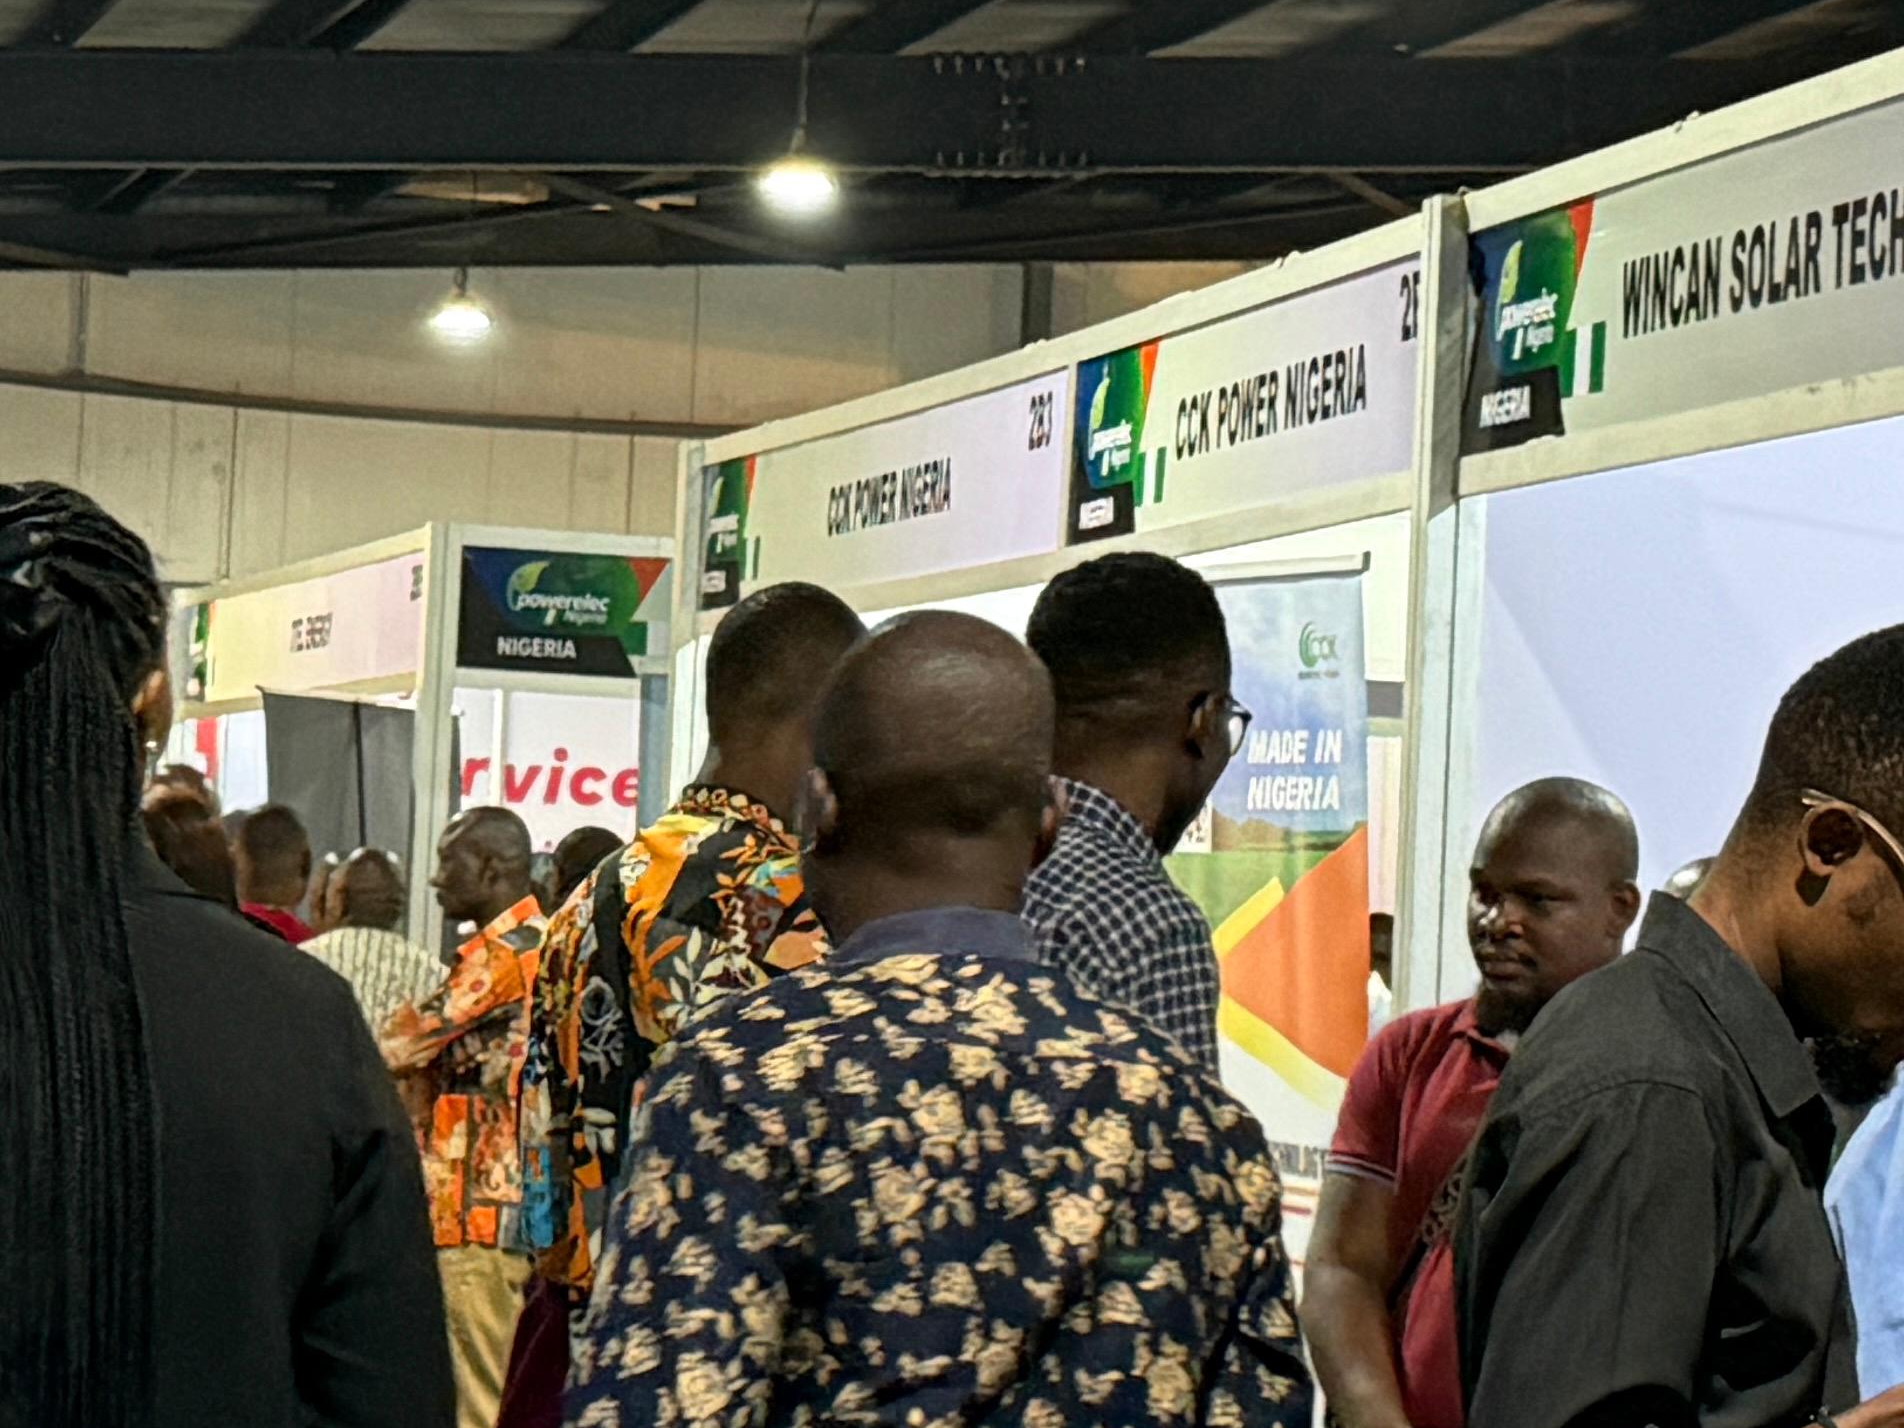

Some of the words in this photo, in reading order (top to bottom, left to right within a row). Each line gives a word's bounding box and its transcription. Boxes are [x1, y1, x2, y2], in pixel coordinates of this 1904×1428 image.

[1623, 236, 1722, 338] WINCAN
[1730, 210, 1822, 313] SOLAR
[1175, 390, 1213, 461] CCK
[1216, 370, 1279, 450] POWER
[1283, 343, 1367, 431] NIGERIA
[854, 471, 897, 531] POWER
[898, 456, 952, 521] NIGERIA
[516, 593, 611, 612] powerelec
[497, 635, 577, 659] NIGERIA
[1247, 728, 1310, 764] MADE
[1314, 728, 1343, 764] IN
[1247, 774, 1341, 811] NIGERIA
